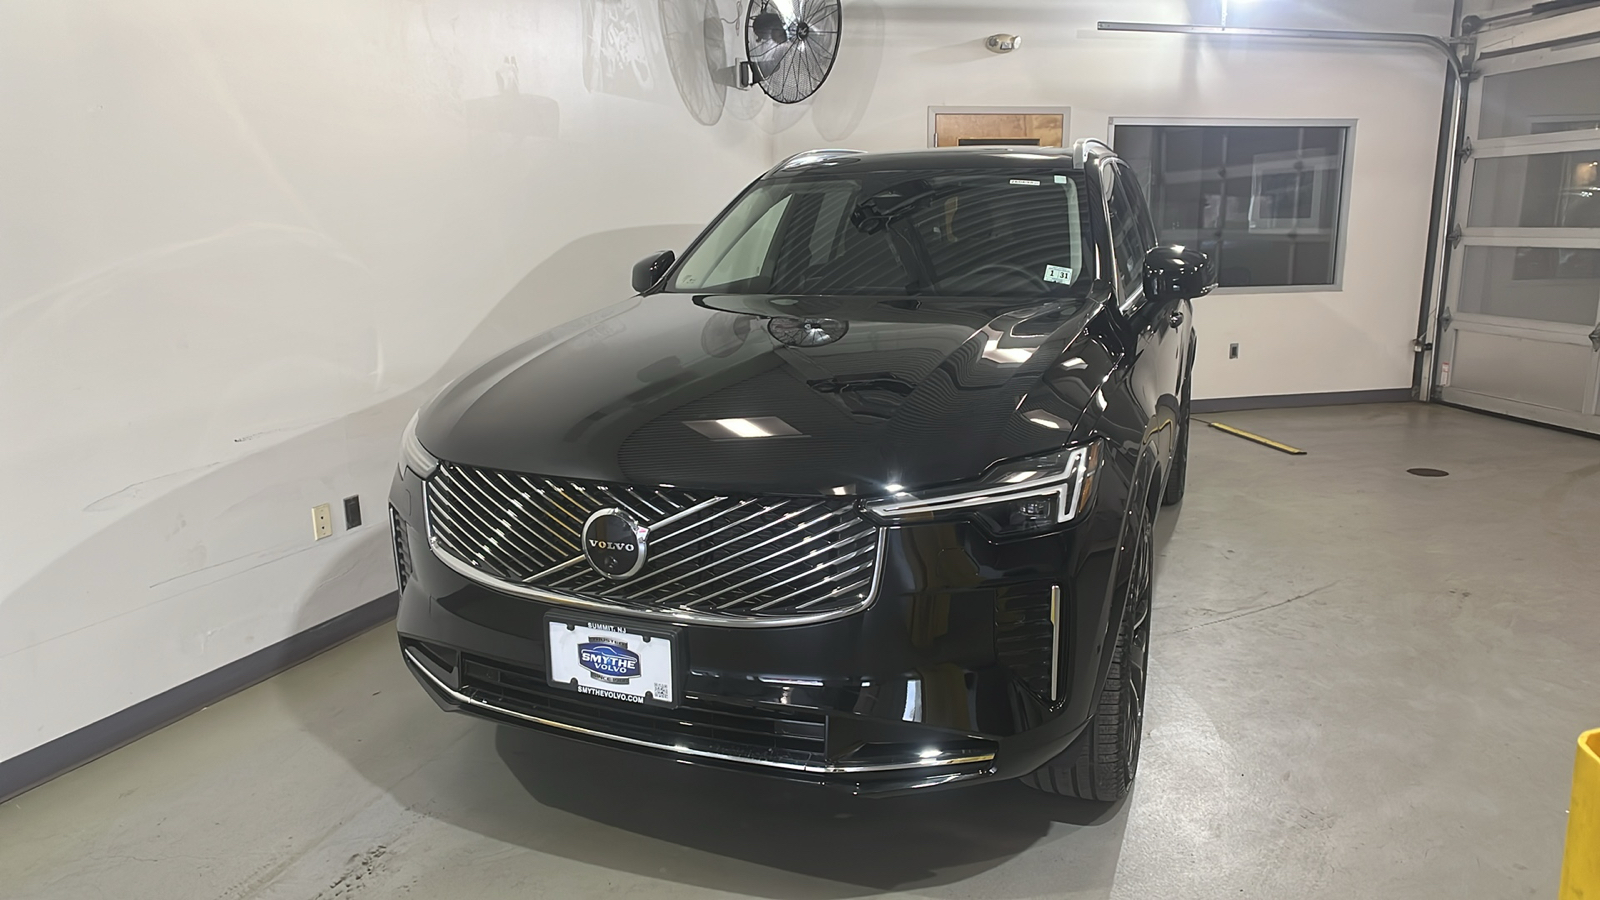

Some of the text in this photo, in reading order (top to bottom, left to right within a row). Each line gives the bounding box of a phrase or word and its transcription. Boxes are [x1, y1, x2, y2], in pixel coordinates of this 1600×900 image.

[589, 539, 634, 552] VOLVO
[617, 626, 626, 634] NJ
[582, 652, 635, 669] SMYTHE
[594, 662, 627, 673] VOLVO
[578, 686, 644, 703] SMYTHEVOLVO.COM
